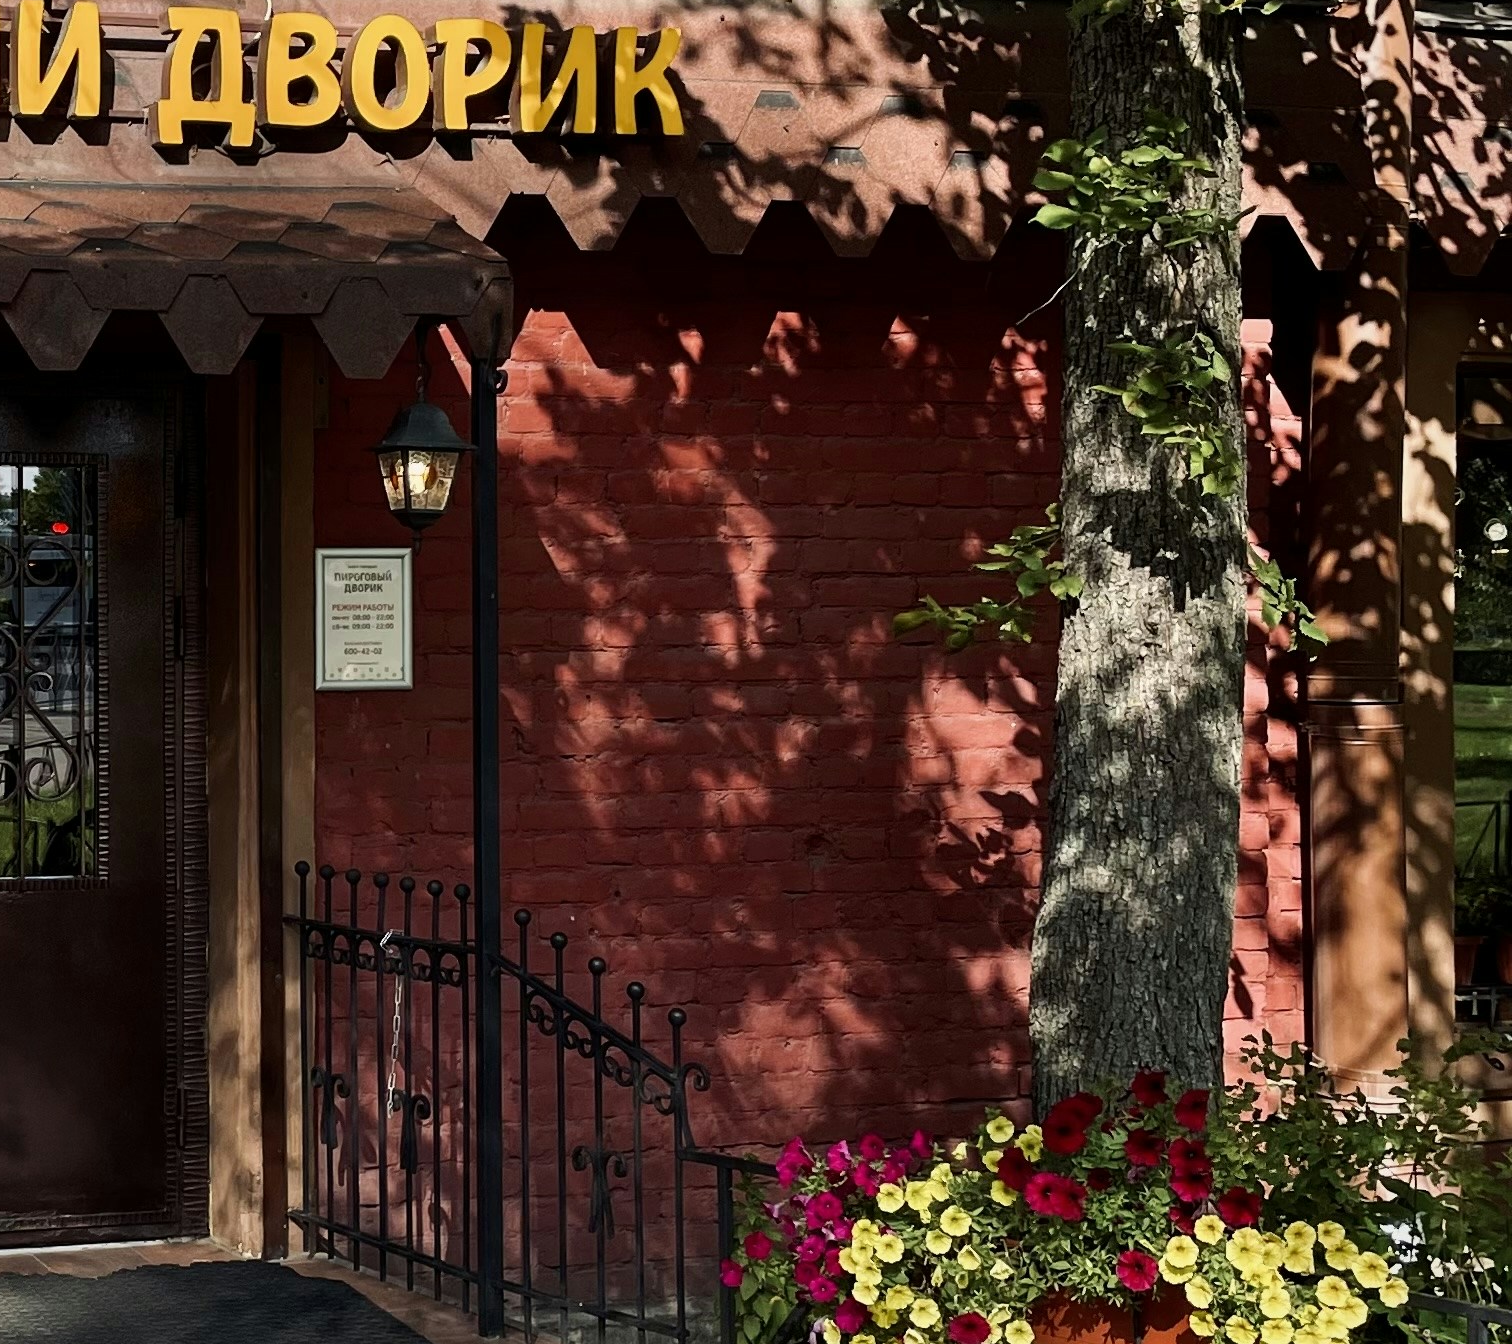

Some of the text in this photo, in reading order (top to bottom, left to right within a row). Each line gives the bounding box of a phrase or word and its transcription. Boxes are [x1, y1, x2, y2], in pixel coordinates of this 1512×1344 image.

[152, 6, 683, 149] ДВОРИК
[334, 570, 392, 581] ПИРОГОВЫЙ
[344, 583, 383, 593] ДВОРИК
[344, 647, 382, 655] 600-42-02
